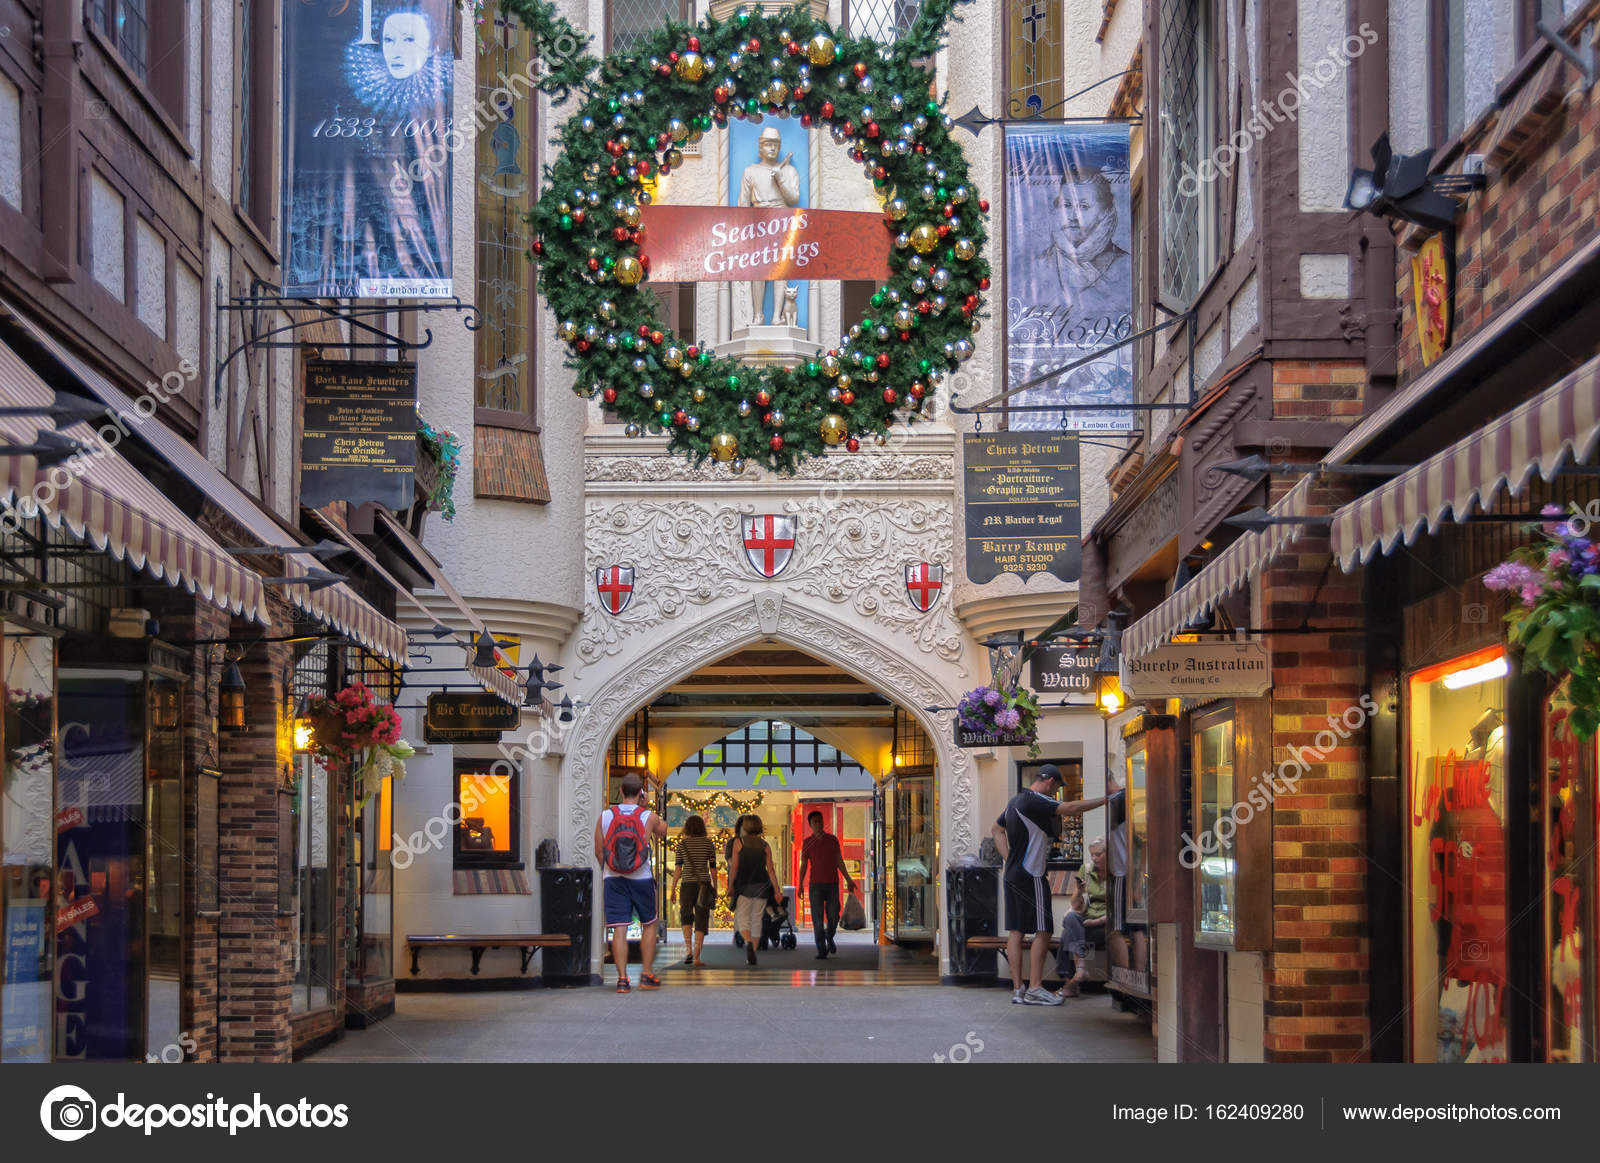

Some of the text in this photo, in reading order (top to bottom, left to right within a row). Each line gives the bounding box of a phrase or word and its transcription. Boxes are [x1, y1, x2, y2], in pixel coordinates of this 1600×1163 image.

[711, 213, 809, 248] Seasons
[703, 241, 820, 275] Greetings
[381, 286, 449, 296] London Court
[315, 375, 409, 386] Park Lane Jewellers
[337, 407, 354, 415] John
[360, 414, 393, 422] Jewellers
[1082, 421, 1131, 429] London Court
[334, 438, 385, 447] Chris Petrou
[333, 446, 386, 455] Alex Grindley
[986, 443, 1060, 456] Chris Petrou
[996, 473, 1050, 485] Portraiture
[986, 484, 1061, 496] Graphic Design
[1005, 515, 1035, 525] Barber
[1037, 514, 1063, 525] Legal
[982, 540, 1068, 554] Barry Kempe
[994, 554, 1054, 563] HAIR STUDIO
[1003, 563, 1047, 572] 9325 5230
[1127, 657, 1265, 674] Purely Australian
[1041, 672, 1090, 690] Watch
[1170, 675, 1205, 684] Clothing
[435, 703, 514, 717] Be Tempted
[57, 811, 81, 830] ALES
[67, 902, 95, 921] SALES
